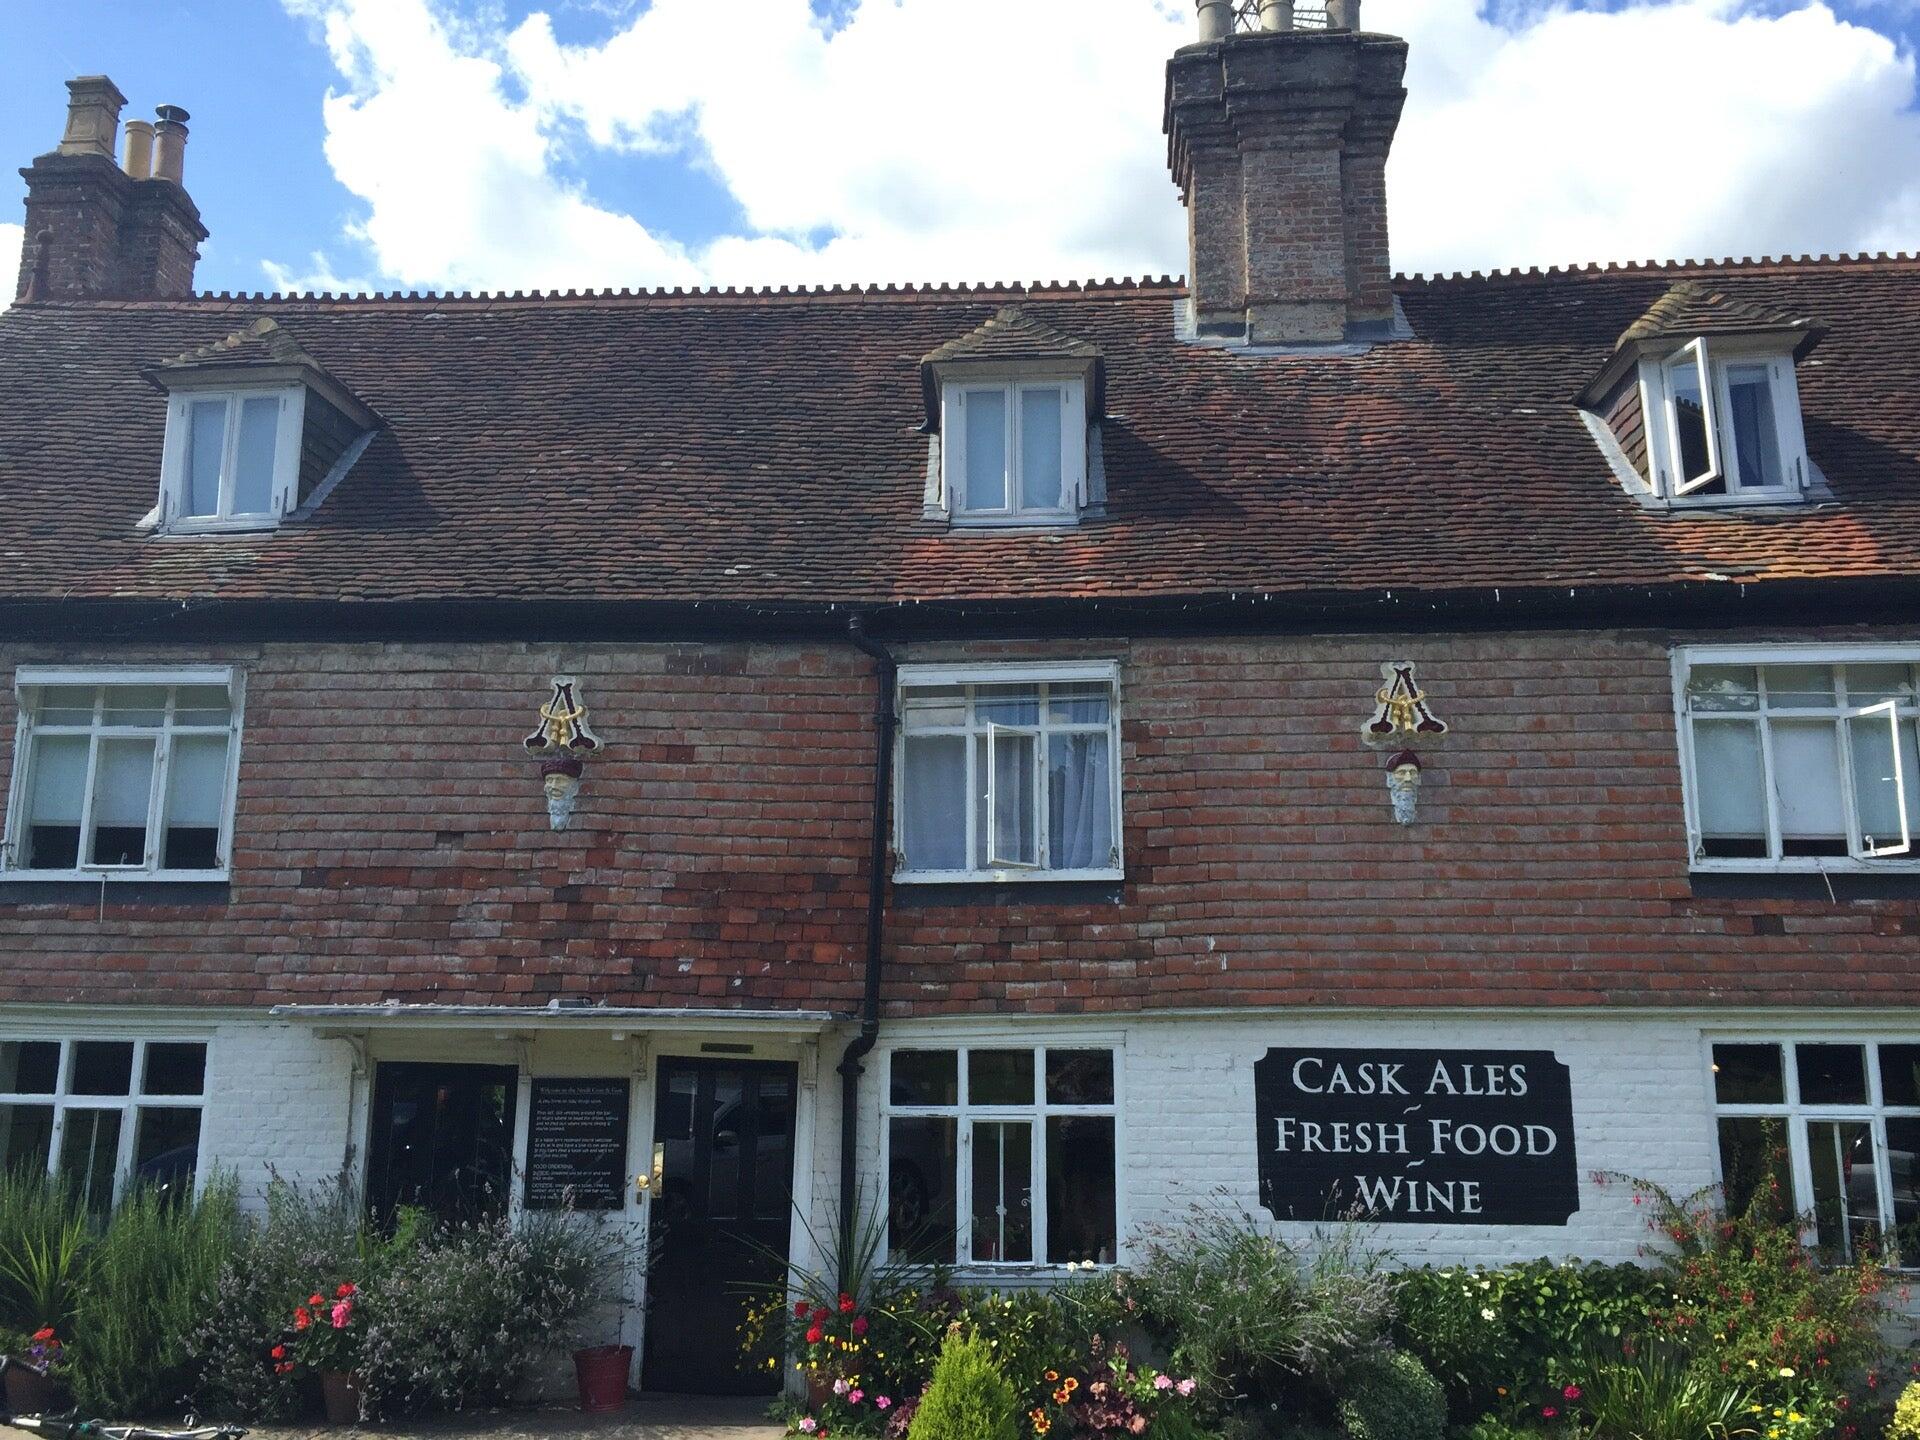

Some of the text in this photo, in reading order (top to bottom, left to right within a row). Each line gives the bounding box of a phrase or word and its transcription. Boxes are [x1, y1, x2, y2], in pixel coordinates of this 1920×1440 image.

[1292, 1057, 1528, 1096] CASK ALES
[1274, 1117, 1557, 1156] FRESH FOOD
[1354, 1175, 1483, 1214] WINE
